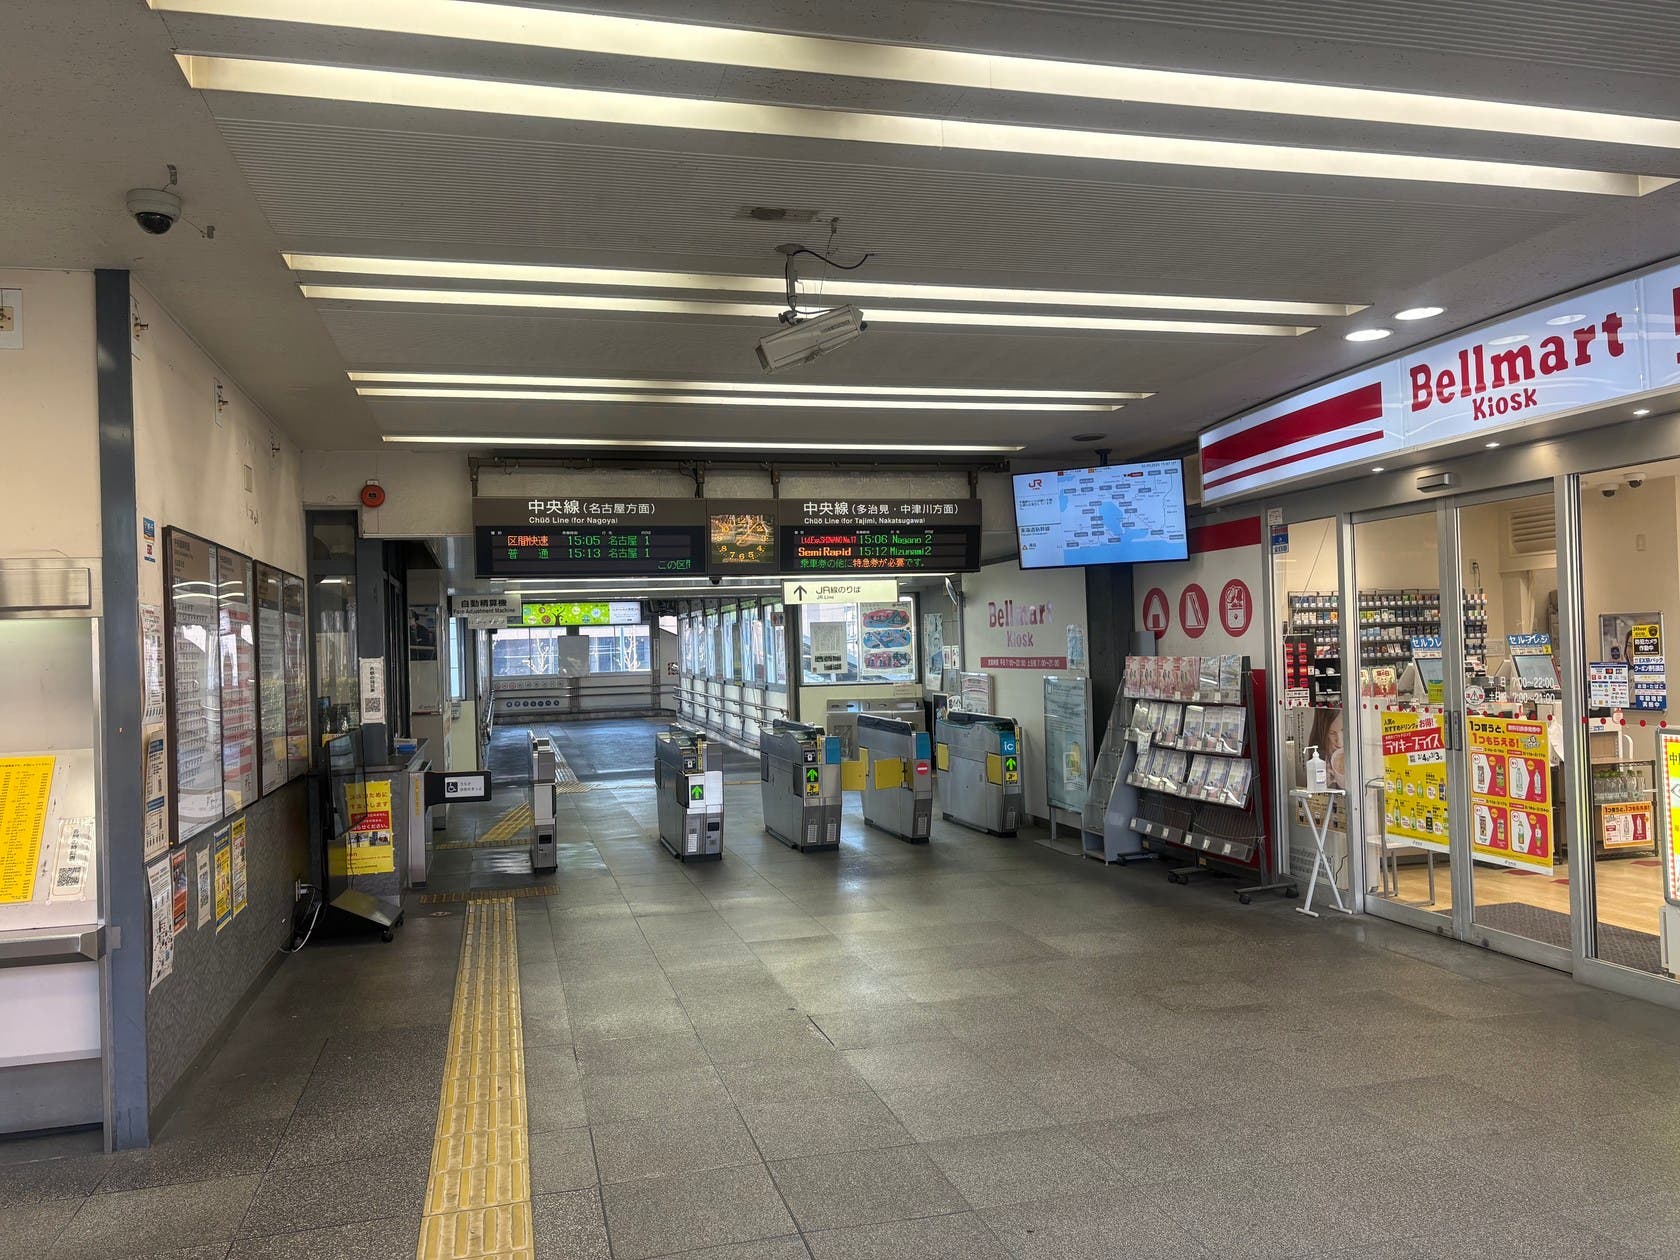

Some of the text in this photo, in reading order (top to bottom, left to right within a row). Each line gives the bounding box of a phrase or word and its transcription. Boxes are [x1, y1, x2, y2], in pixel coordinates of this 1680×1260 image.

[1410, 311, 1625, 412] Bellmart
[1473, 387, 1538, 421] Kiosk
[1028, 479, 1042, 488] JR
[586, 517, 618, 525] Nagoya)
[855, 517, 878, 525] Tajimi,
[878, 517, 925, 525] Nakatsugawa)
[507, 535, 650, 546] 区間快速 15:05 名古屋 1
[859, 534, 888, 544] 15:06
[892, 534, 922, 544] Nagano
[925, 534, 932, 543] 2
[568, 549, 601, 558] 15:13
[608, 548, 638, 558] 名古屋
[644, 549, 650, 558] 1
[798, 546, 932, 556] Semi Rapid 15:12 Mizunami 2
[816, 585, 861, 594] JR線のりば
[460, 599, 507, 608] 自動精算機
[988, 600, 1054, 628] Bellmart
[1006, 631, 1034, 648] Kiosk
[1509, 634, 1548, 644] セルフレジ
[1470, 721, 1506, 734] 1つ買うと、
[1472, 733, 1519, 748] 1つもらえる!
[1669, 752, 1680, 766] 中
